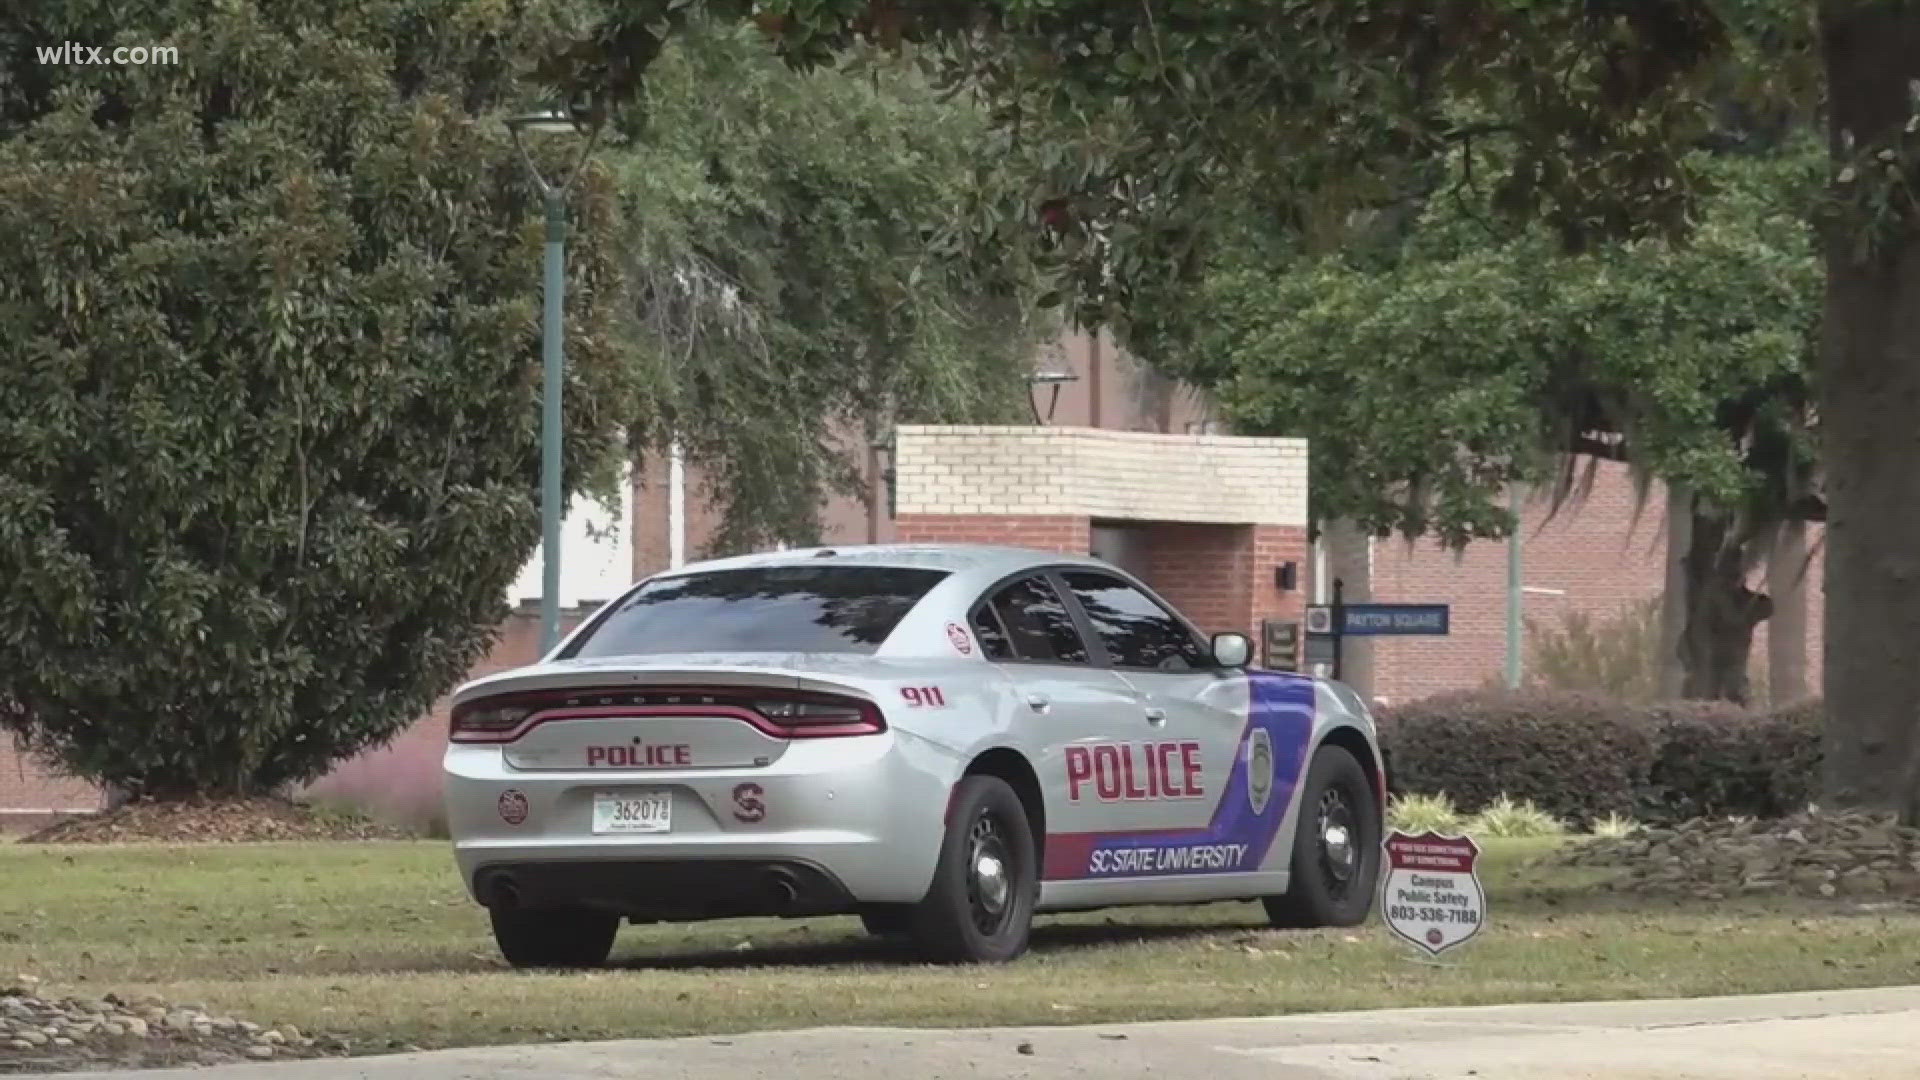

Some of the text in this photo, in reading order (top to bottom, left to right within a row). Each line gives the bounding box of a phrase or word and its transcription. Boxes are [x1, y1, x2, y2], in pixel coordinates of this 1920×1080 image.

[901, 686, 945, 706] 911
[587, 744, 692, 766] POLICE
[1064, 742, 1205, 801] POLICE
[613, 800, 659, 820] 36207
[1089, 843, 1249, 873] SC STATE UNIVERSITY
[1411, 874, 1454, 890] Campus
[1398, 889, 1468, 907] Public Safety
[1391, 905, 1477, 924] 803-536-7188
